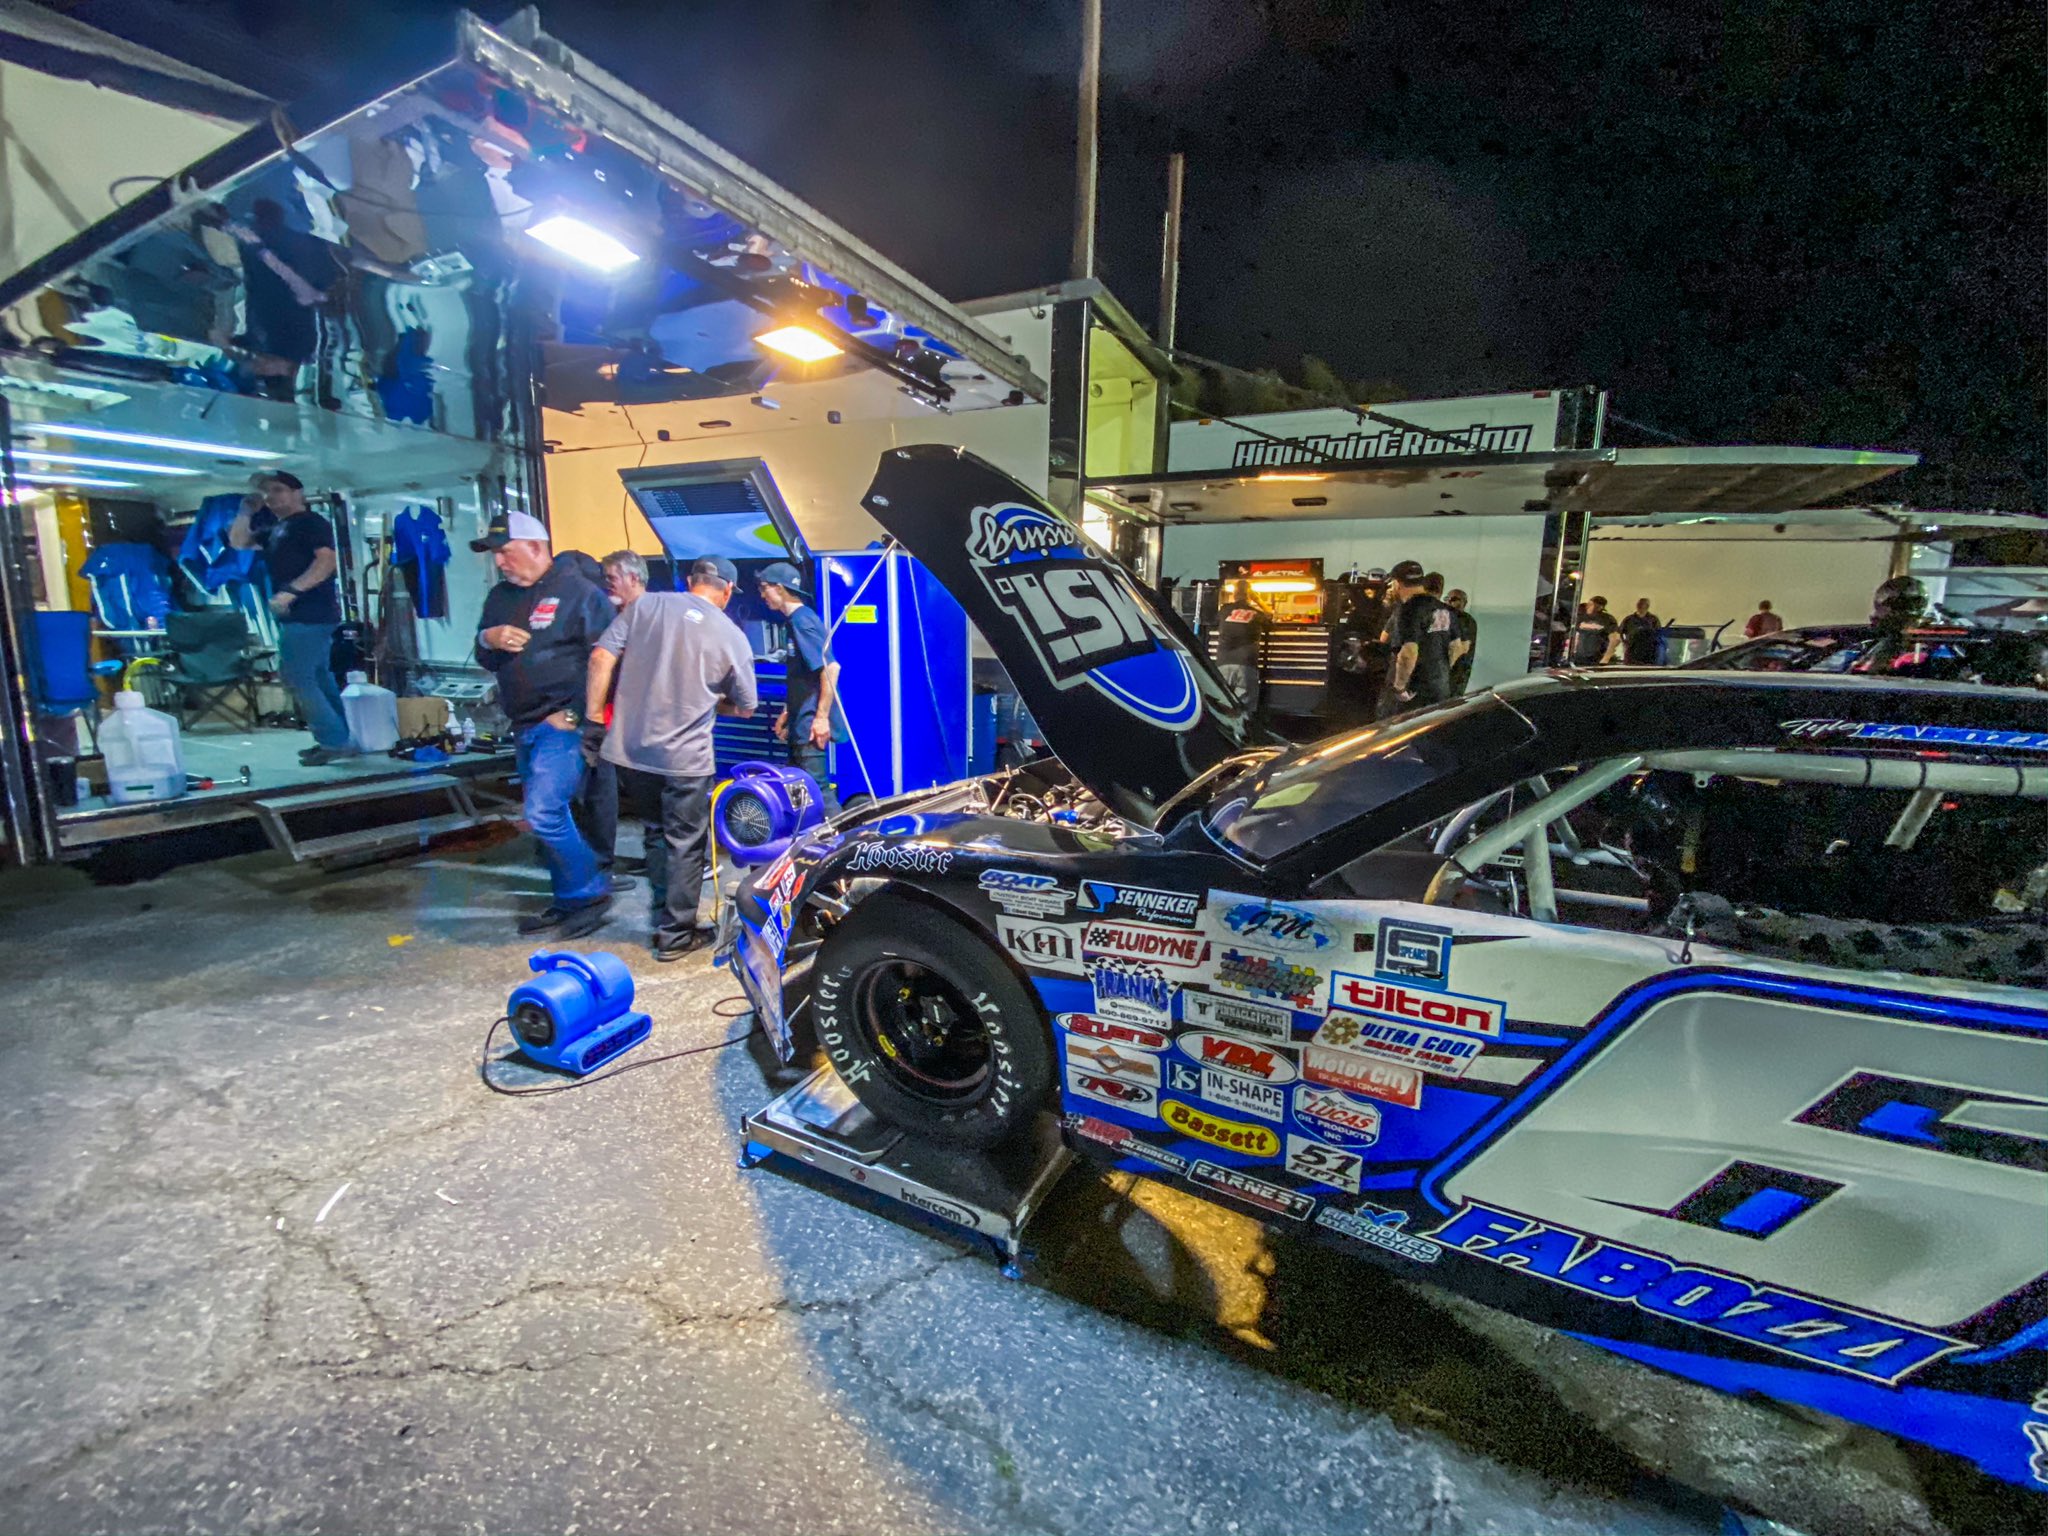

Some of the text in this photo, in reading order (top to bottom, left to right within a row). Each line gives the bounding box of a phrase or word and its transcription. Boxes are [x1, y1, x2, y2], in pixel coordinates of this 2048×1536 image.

[846, 840, 954, 874] Hoosier
[1115, 889, 1198, 915] SENNEKER
[1135, 907, 1194, 924] Performance
[1107, 929, 1197, 960] FLUIDYNE
[1342, 981, 1492, 1032] tilton
[815, 975, 871, 1085] Hoosier
[1360, 1022, 1477, 1058] ULTRA COOL
[972, 992, 1022, 1116] Hoosier
[1307, 1050, 1366, 1080] Motor
[1370, 1067, 1416, 1095] City
[1357, 1083, 1389, 1096] GMC
[1207, 1072, 1283, 1108] IN-SHAPE
[1171, 1106, 1268, 1151] Bassett
[1297, 1113, 1374, 1142] OIL PRODUCTS
[1303, 1102, 1377, 1130] LUCAS
[1323, 1130, 1342, 1143] INC
[1289, 1161, 1360, 1190] FIFTY
[1291, 1144, 1361, 1178] 51
[900, 1187, 962, 1222] Intercom
[1197, 1164, 1309, 1211] EARNEST
